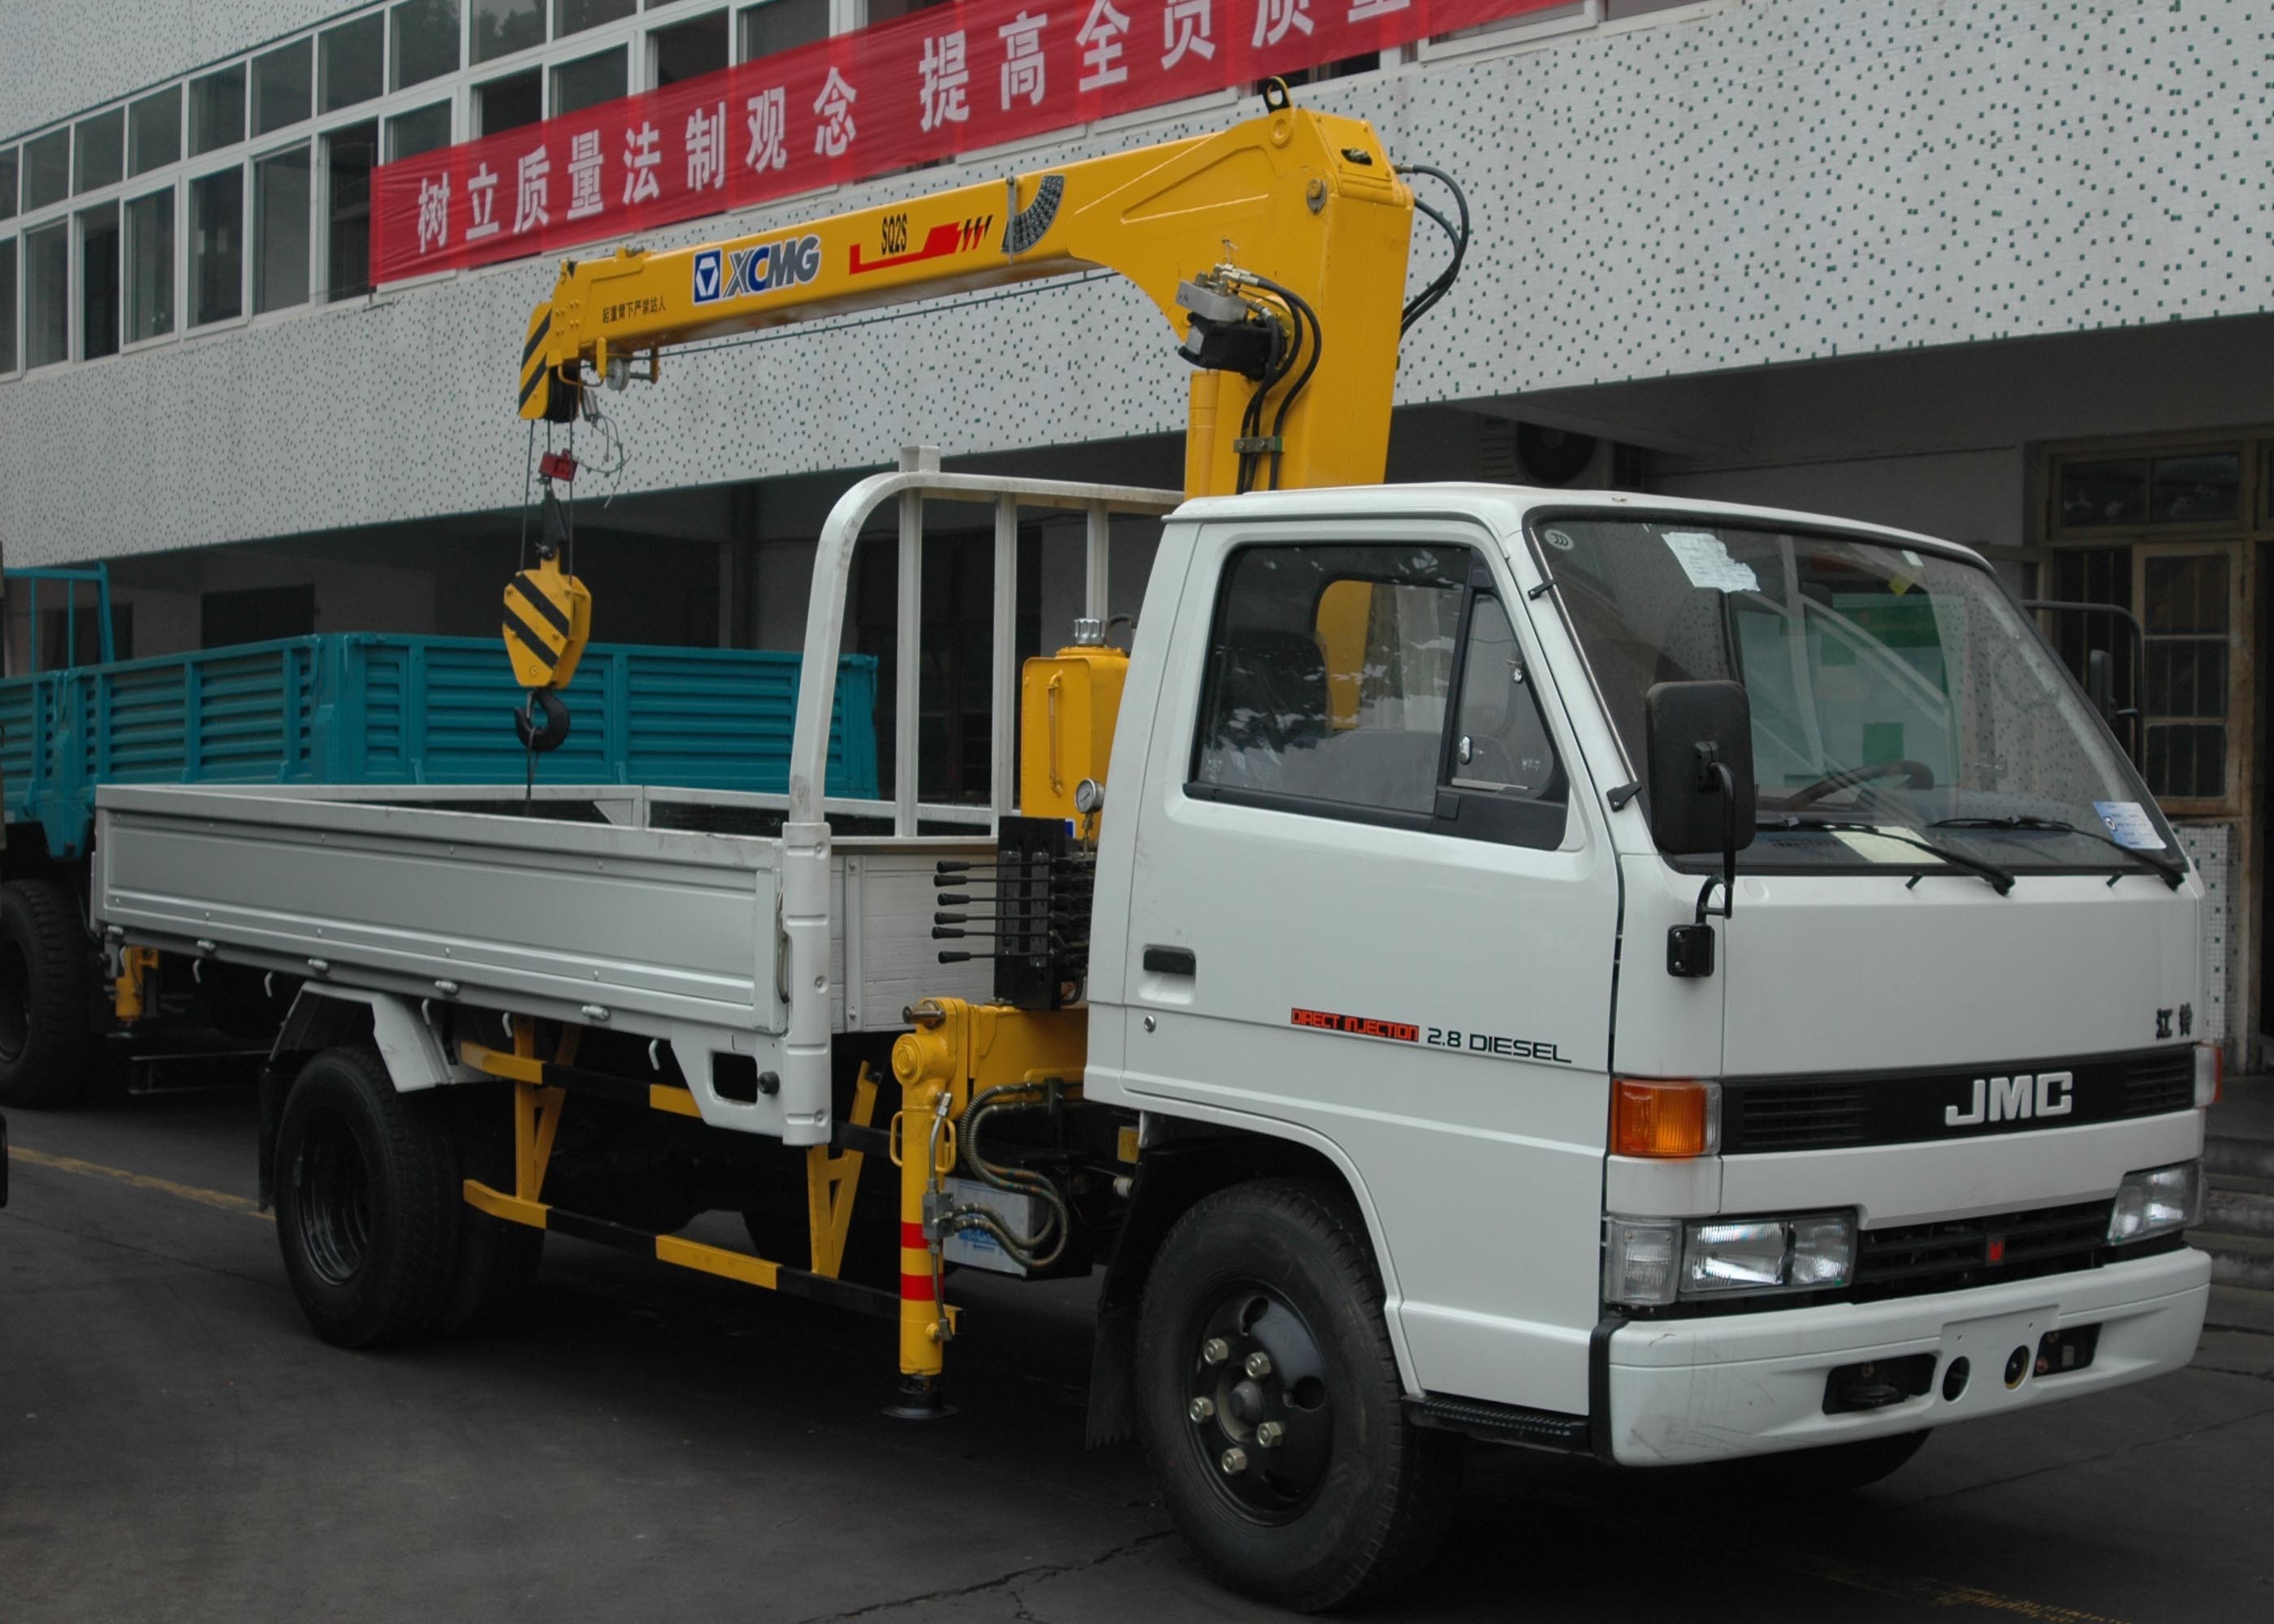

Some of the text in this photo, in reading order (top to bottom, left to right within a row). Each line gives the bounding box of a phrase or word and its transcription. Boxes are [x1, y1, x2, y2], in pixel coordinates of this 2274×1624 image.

[417, 66, 857, 254] 树立质量法制观念
[919, 0, 1411, 132] 提高全员质
[722, 234, 820, 298] XCMG
[1292, 1009, 1571, 1063] DIRECT INJECTION 2.8 DIESEL
[1945, 1071, 2073, 1126] JMC
